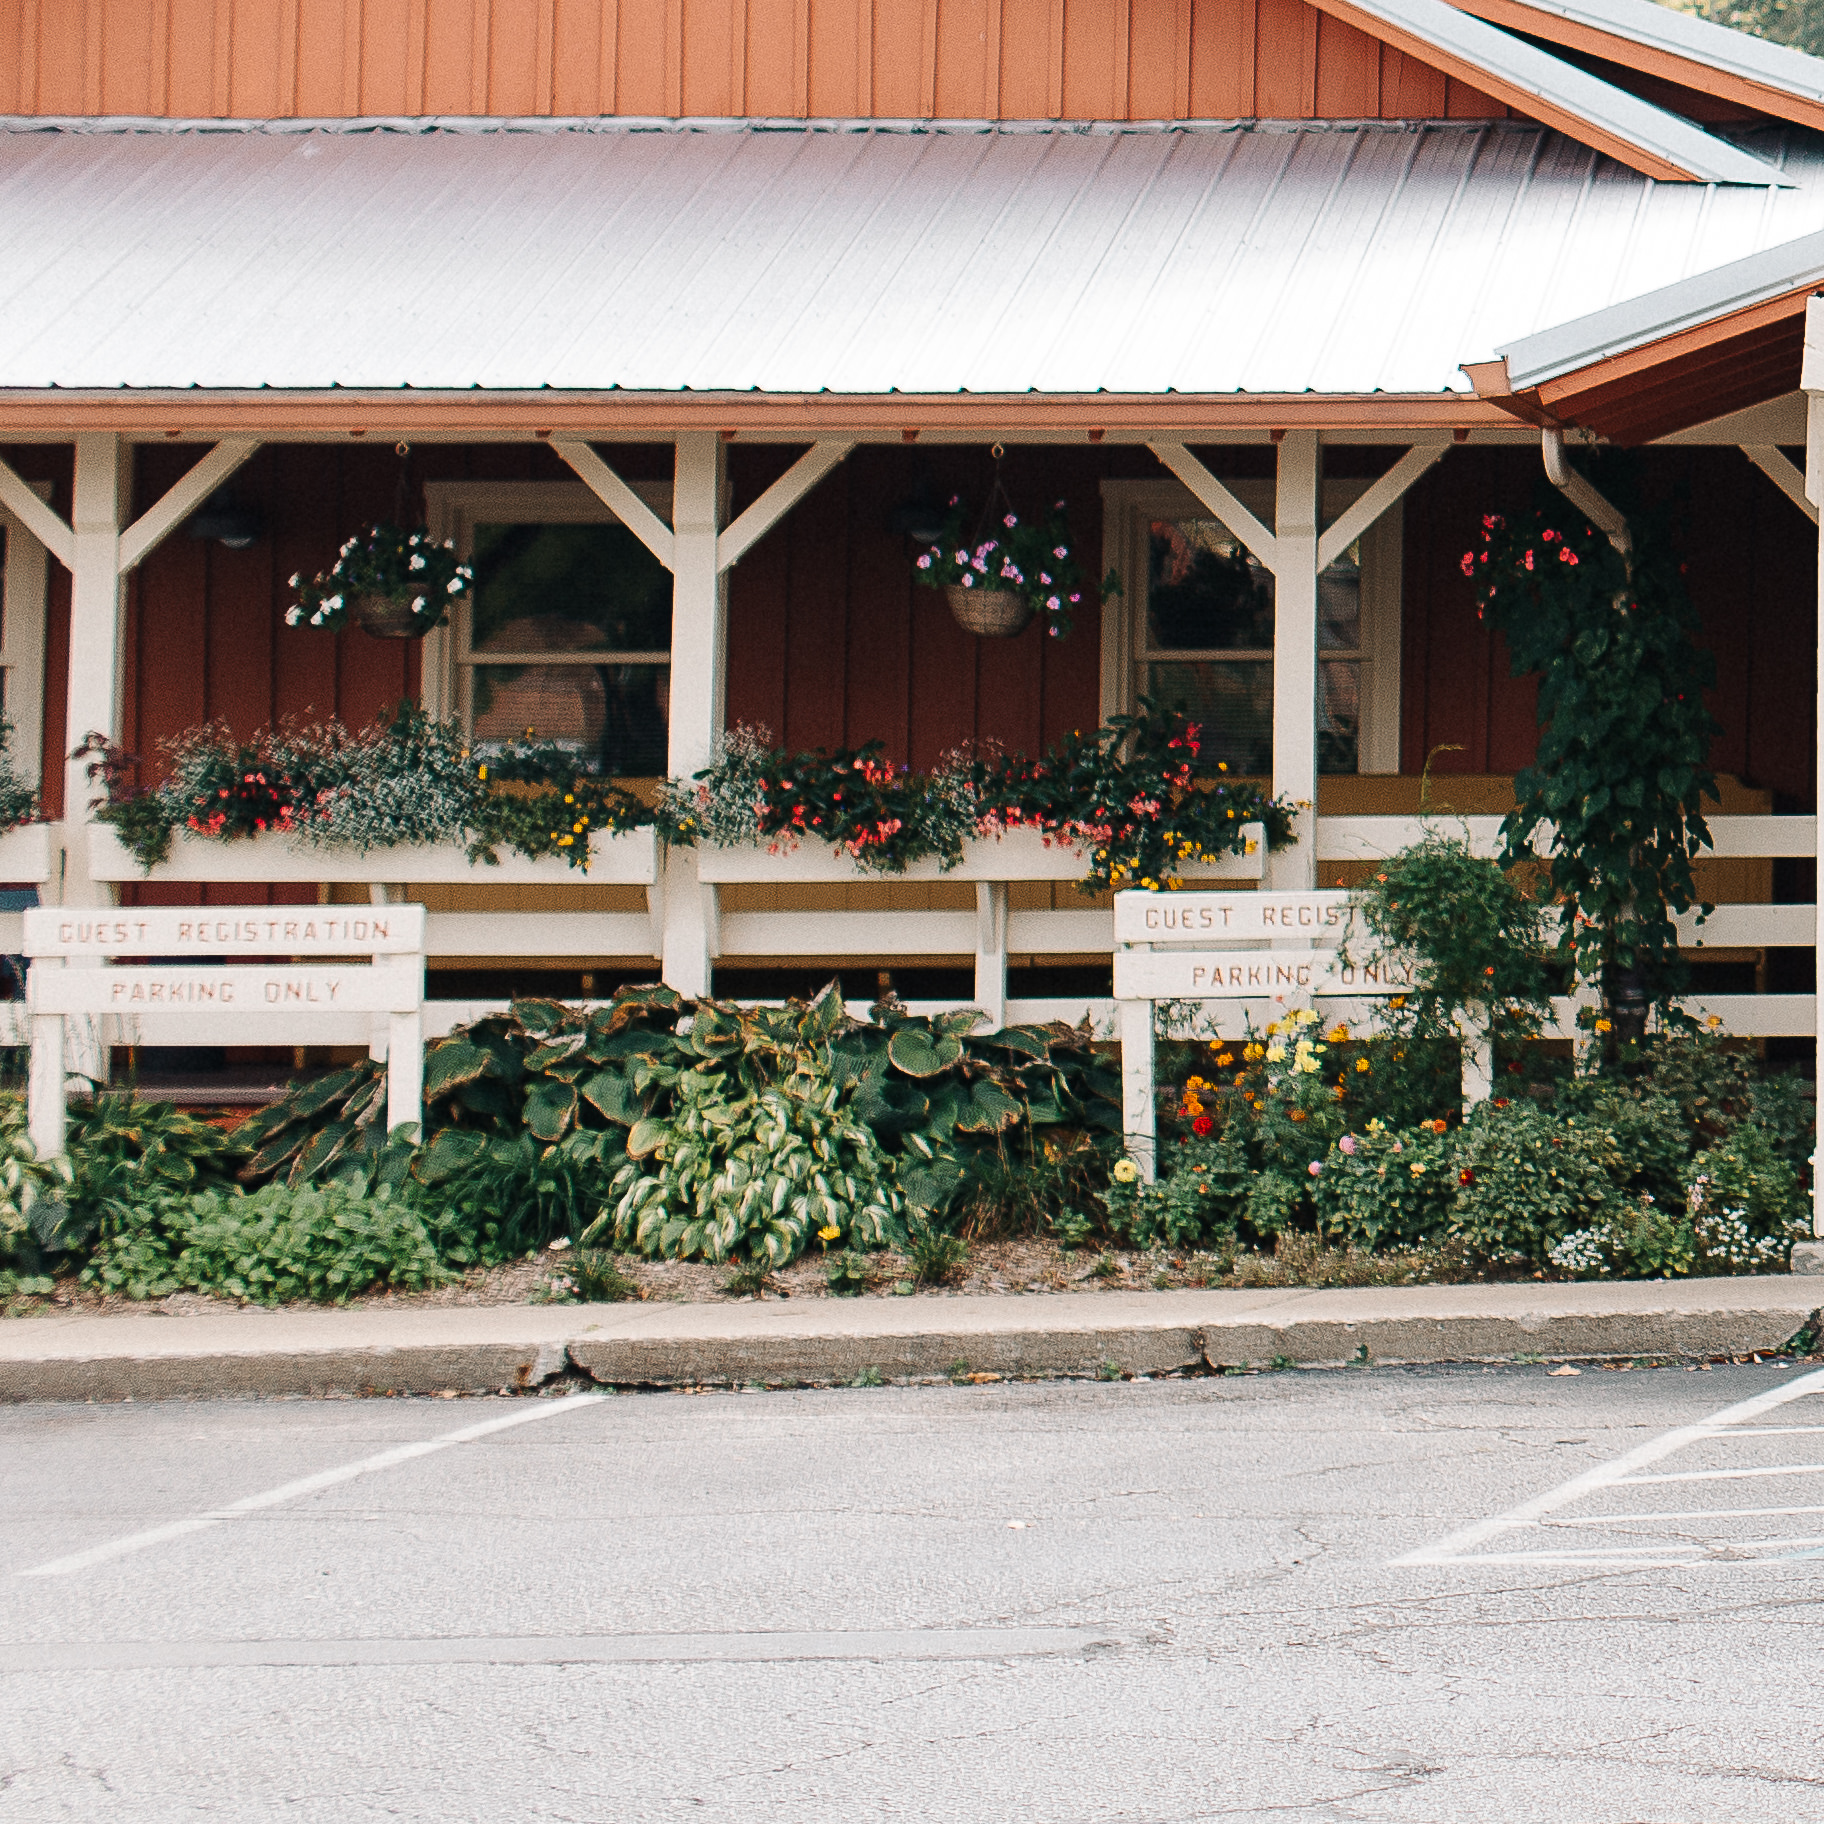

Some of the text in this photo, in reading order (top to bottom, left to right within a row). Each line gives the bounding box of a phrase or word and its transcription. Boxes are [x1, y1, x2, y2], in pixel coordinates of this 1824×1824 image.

[1146, 907, 1233, 929] GUEST
[59, 920, 391, 943] GUEST REGISTRATION
[1193, 964, 1414, 987] PARKING ONLY
[112, 979, 341, 1003] PARKING ONLY
